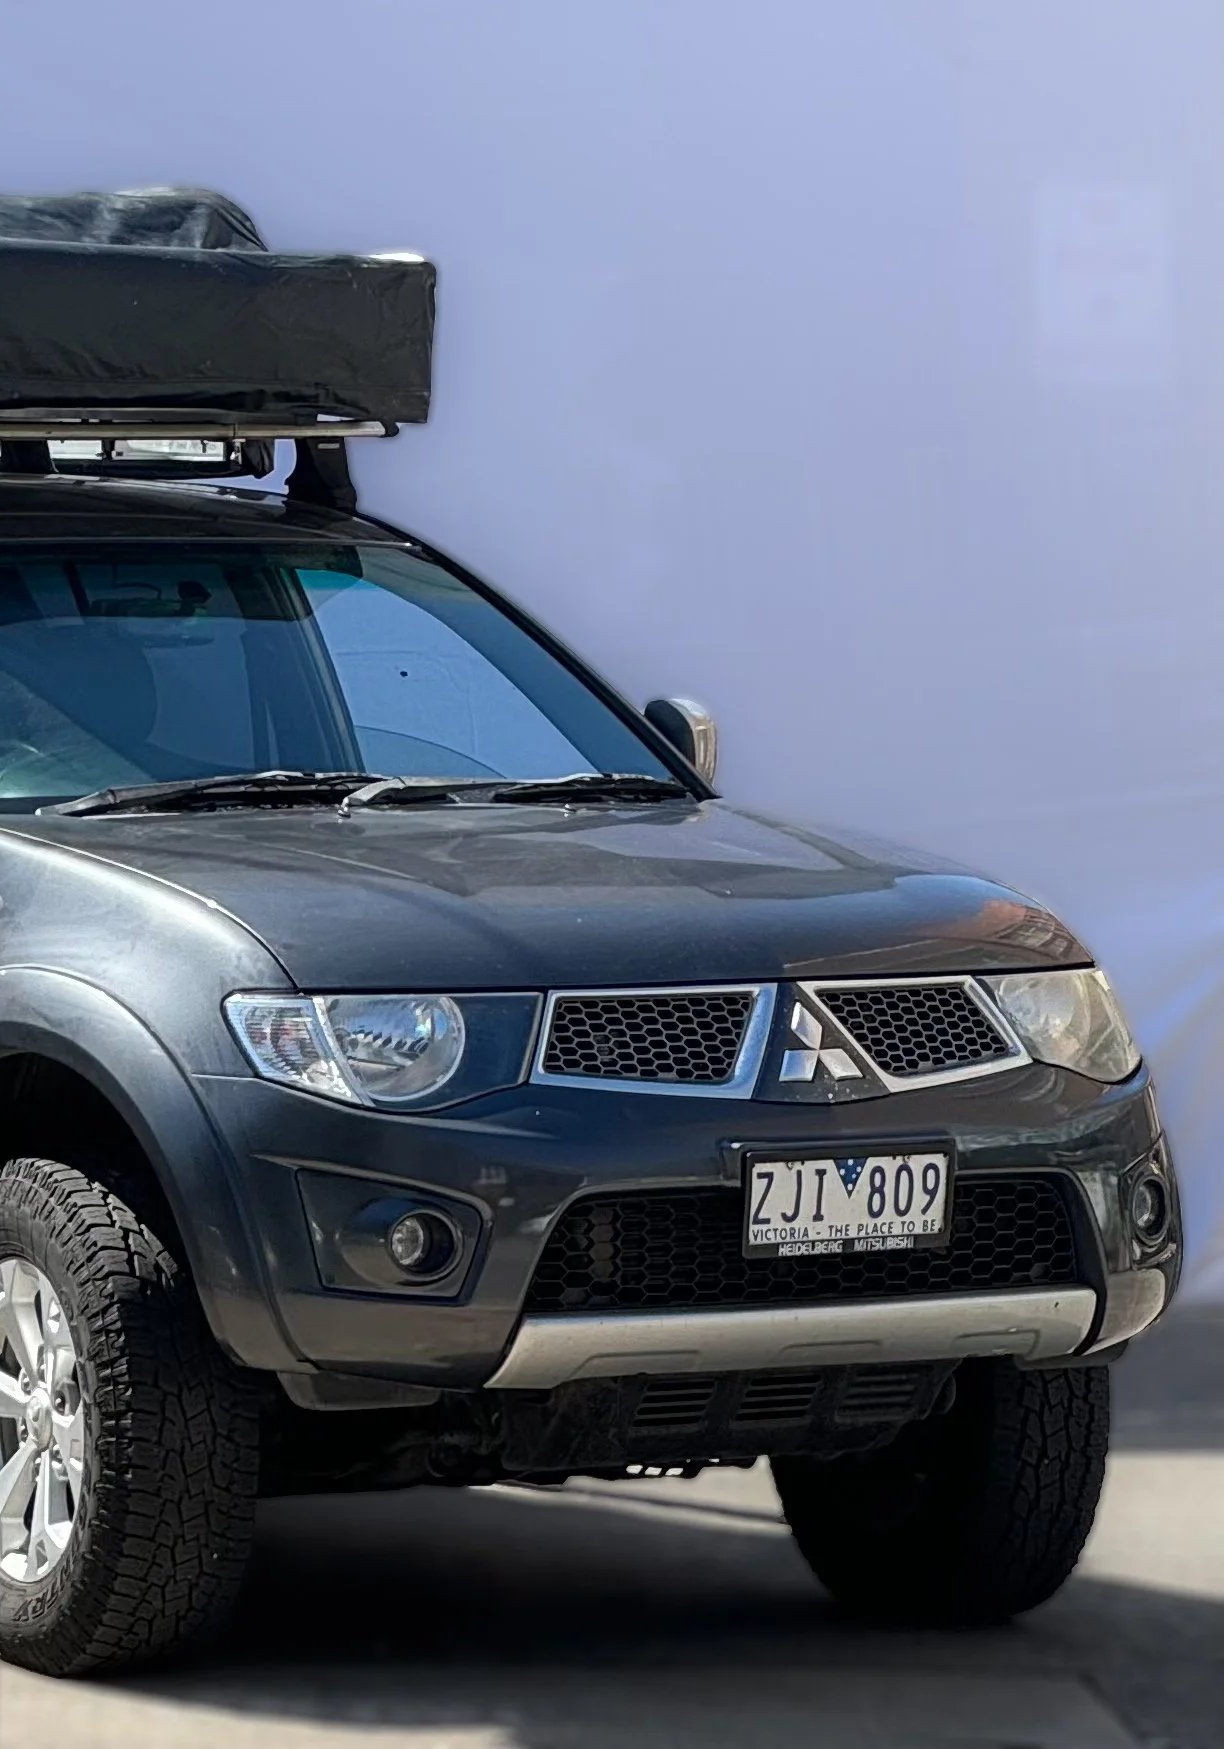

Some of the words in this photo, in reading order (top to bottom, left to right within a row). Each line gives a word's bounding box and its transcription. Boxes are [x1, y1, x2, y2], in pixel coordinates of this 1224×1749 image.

[752, 1168, 827, 1225] ZJI
[867, 1162, 940, 1219] 809
[752, 1227, 810, 1241] VICTORIA
[828, 1224, 850, 1237] THE
[857, 1221, 894, 1235] PLACE
[901, 1220, 915, 1233] TO
[778, 1240, 844, 1256] HEIDELBERG
[854, 1236, 914, 1251] MITSUBISHI
